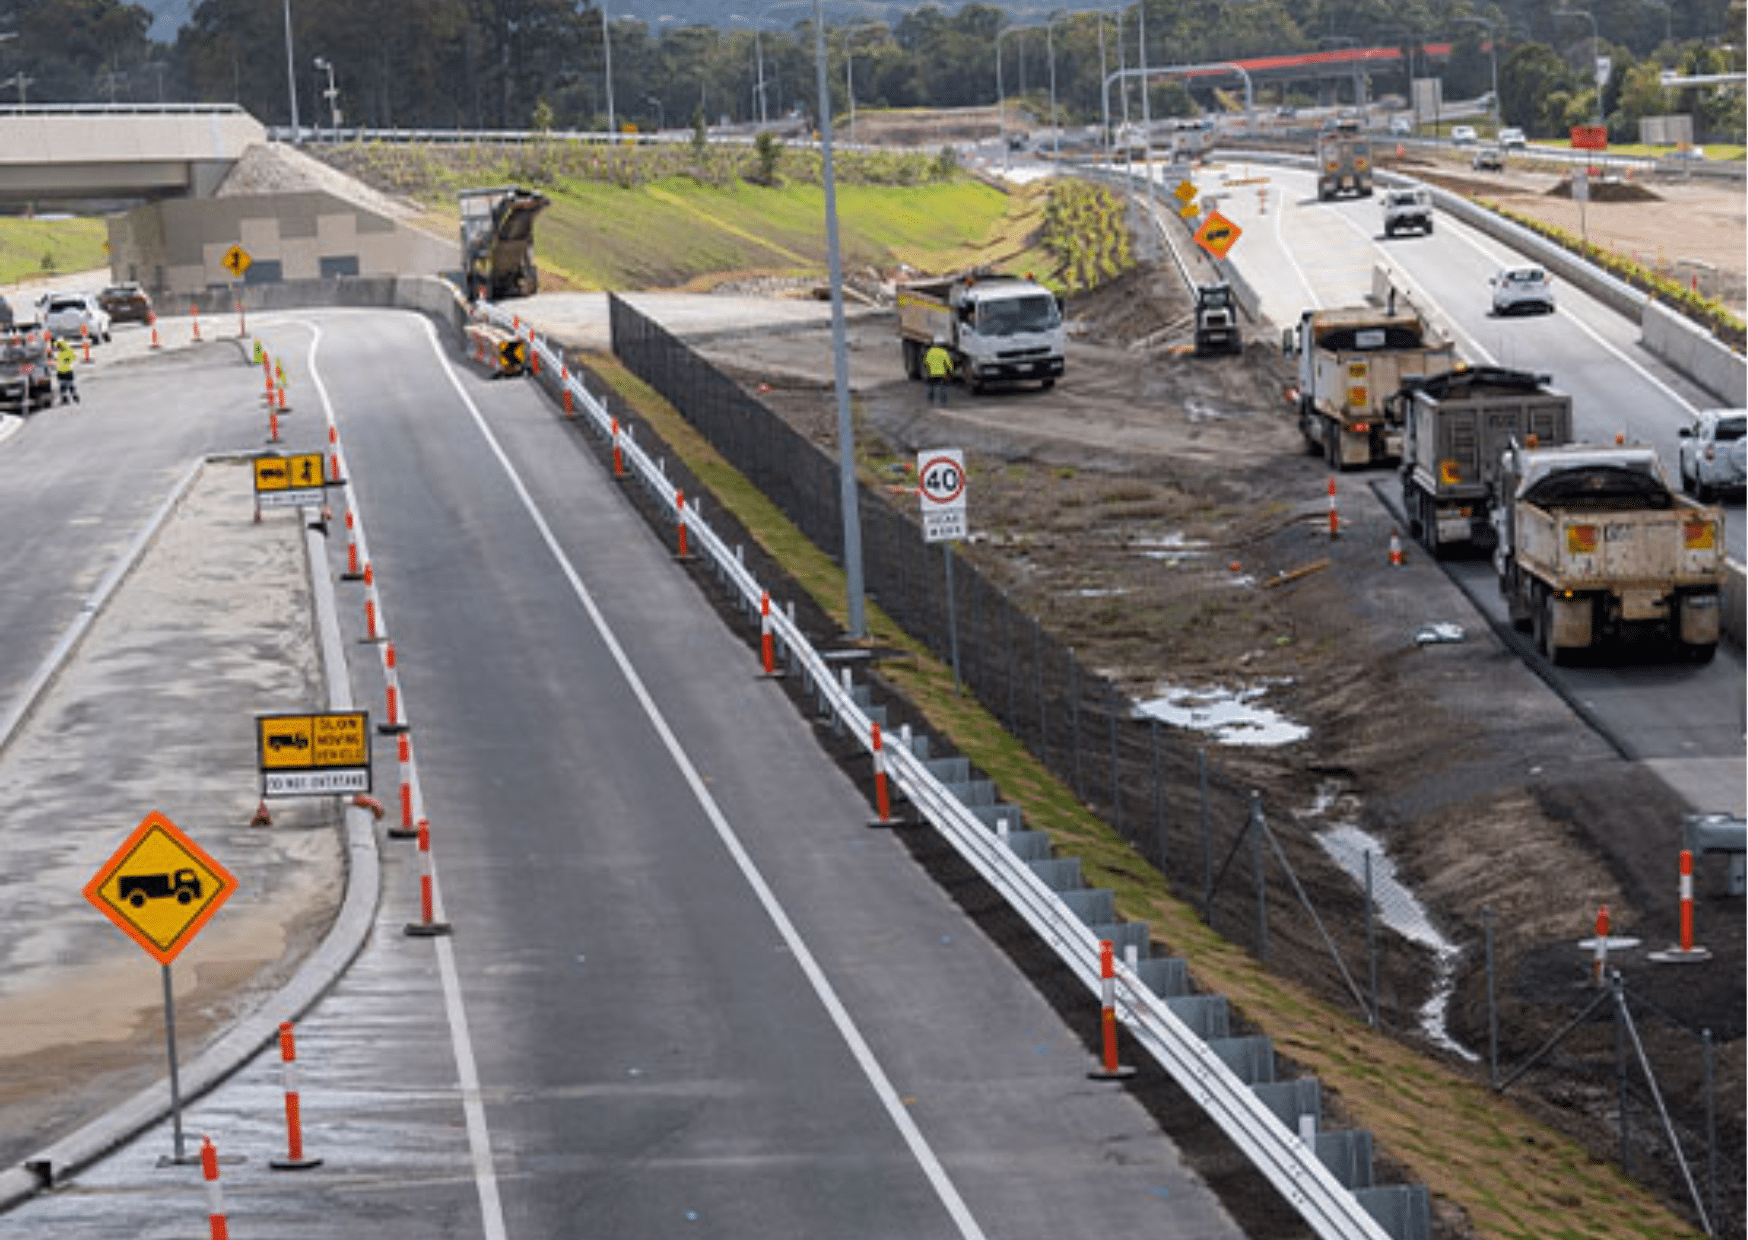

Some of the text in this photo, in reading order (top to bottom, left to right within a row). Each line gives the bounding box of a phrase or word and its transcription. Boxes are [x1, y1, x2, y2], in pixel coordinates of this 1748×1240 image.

[926, 468, 958, 491] 40
[320, 718, 358, 731] SLOW
[317, 733, 361, 746] MOVING
[268, 773, 364, 790] DO NOT OVERTAKE
